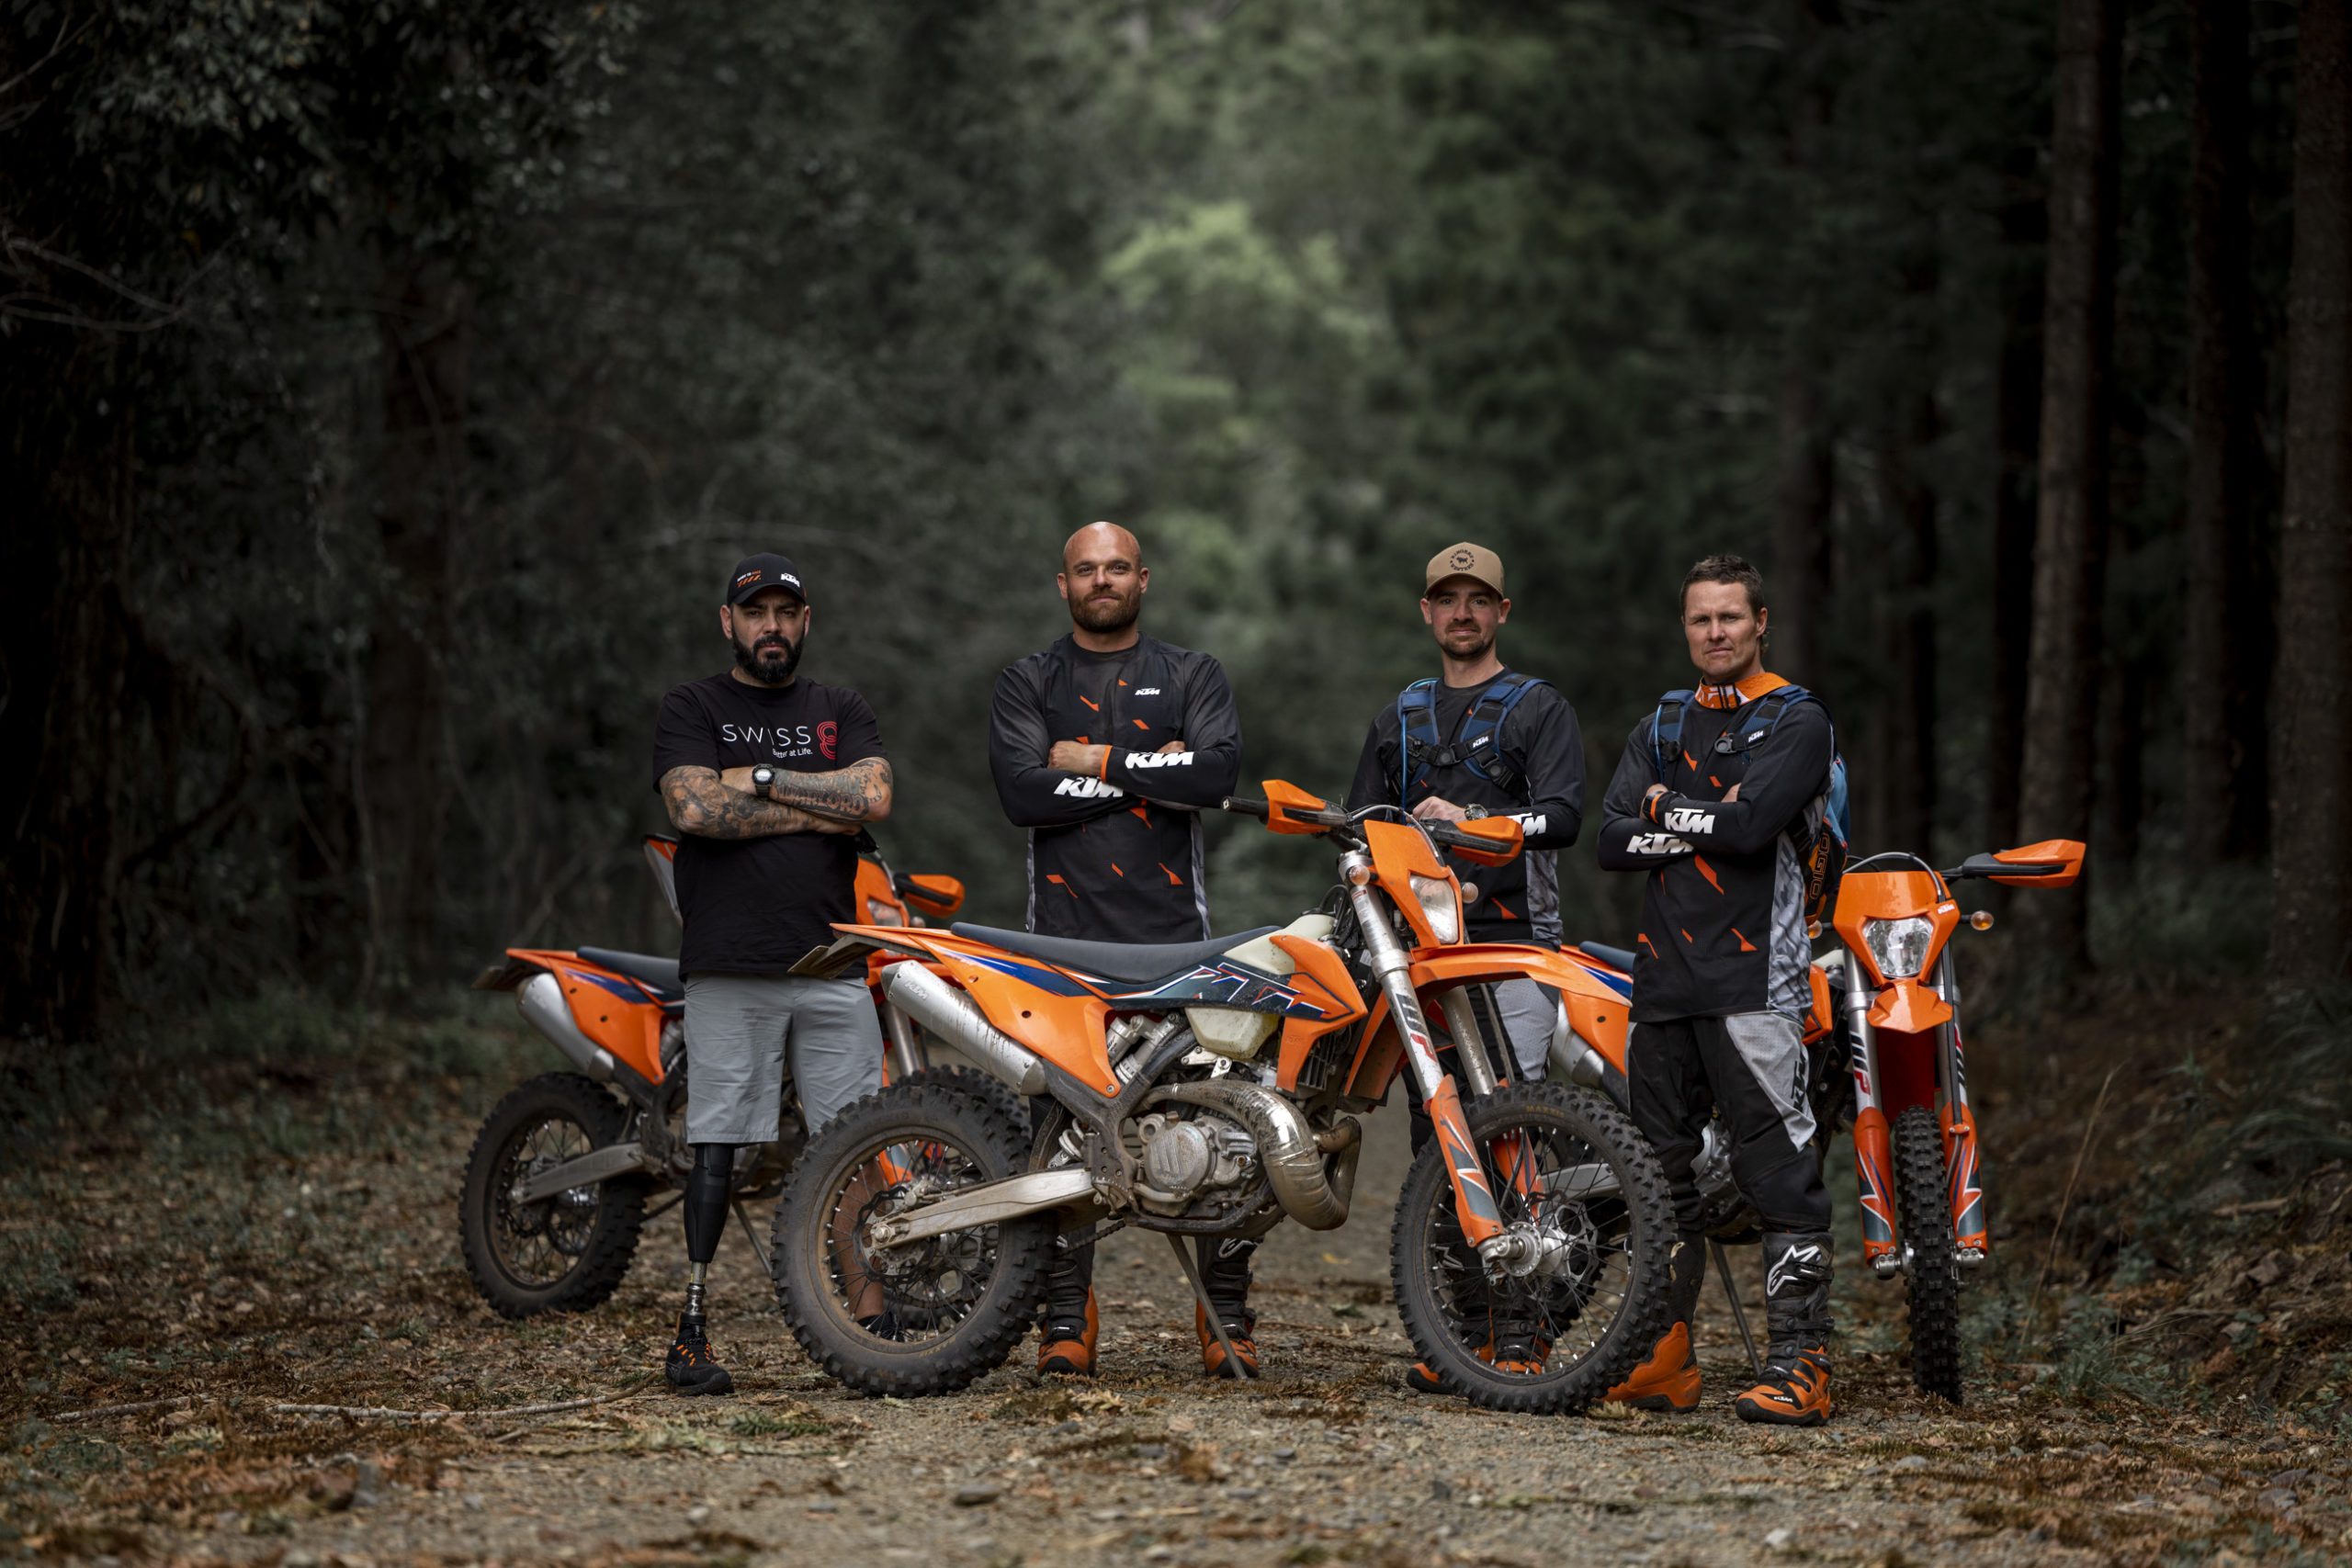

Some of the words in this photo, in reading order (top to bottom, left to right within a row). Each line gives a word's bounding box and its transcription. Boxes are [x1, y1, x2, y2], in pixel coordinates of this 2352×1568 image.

[722, 724, 811, 747] SWISS
[1472, 736, 1489, 748] KTM
[789, 749, 797, 757] at
[797, 747, 813, 756] Life.
[1125, 751, 1194, 769] KTM
[1054, 777, 1124, 798] KTM
[1507, 812, 1546, 837] TM
[1665, 807, 1715, 834] KTM
[1626, 832, 1694, 854] KTM
[1809, 831, 1831, 900] OGIO
